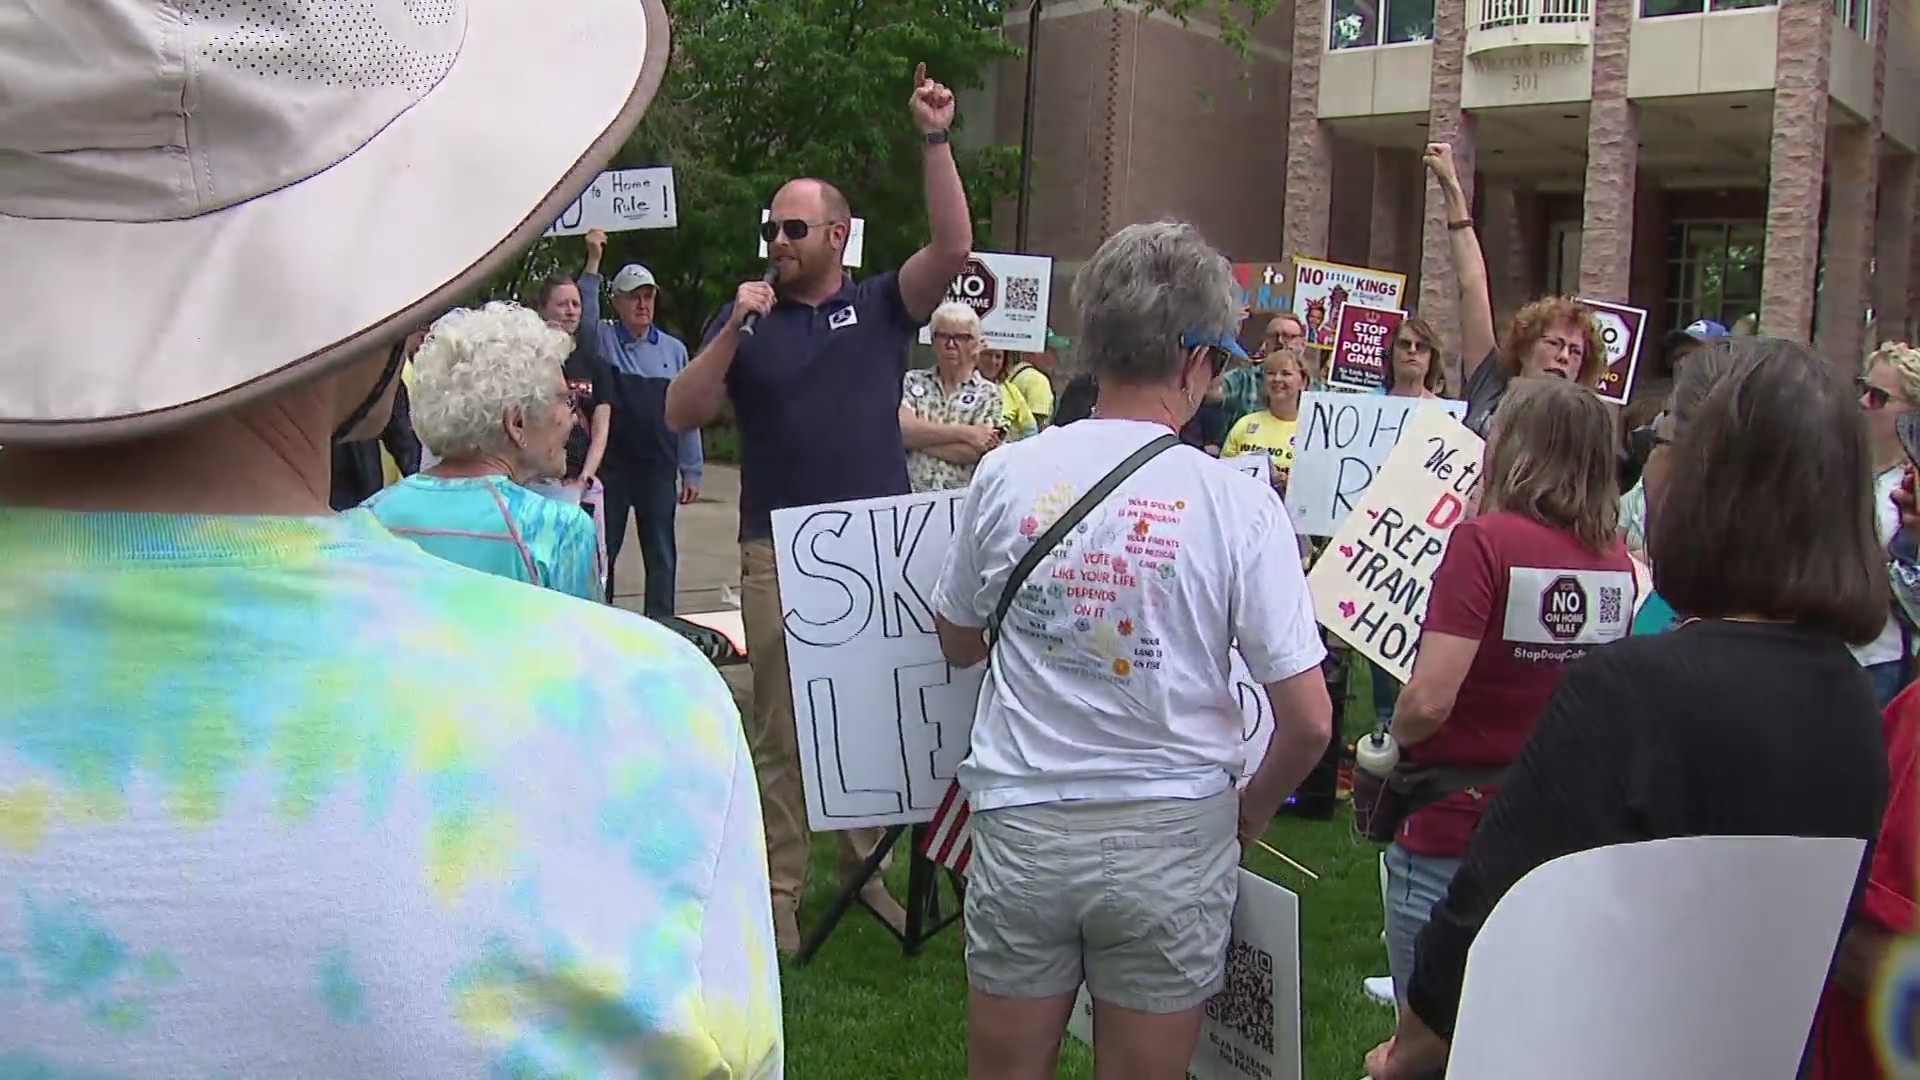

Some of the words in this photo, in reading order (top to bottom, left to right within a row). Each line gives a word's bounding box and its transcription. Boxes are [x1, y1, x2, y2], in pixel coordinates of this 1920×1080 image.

[1512, 73, 1539, 91] 301
[612, 172, 651, 193] Home
[613, 195, 651, 214] Rule
[1263, 265, 1284, 285] to
[1299, 266, 1325, 286] NO
[1356, 277, 1398, 297] KINGS
[1353, 321, 1389, 336] STOP
[1356, 332, 1383, 347] THE
[1342, 340, 1385, 357] POWE
[1346, 352, 1383, 368] GRAB
[1304, 400, 1360, 452] NO
[1368, 506, 1443, 568] REP
[1083, 552, 1111, 566] VOTE
[1052, 565, 1076, 580] LIKE
[1080, 569, 1110, 584] YOUR
[1113, 573, 1137, 588] LIFE
[1066, 586, 1117, 603] DEPENDS
[1552, 591, 1581, 613] NO
[1074, 603, 1092, 617] ON
[1094, 607, 1105, 619] IT
[1544, 612, 1561, 623] ON
[1561, 613, 1584, 623] HOME
[1556, 623, 1577, 633] RULE
